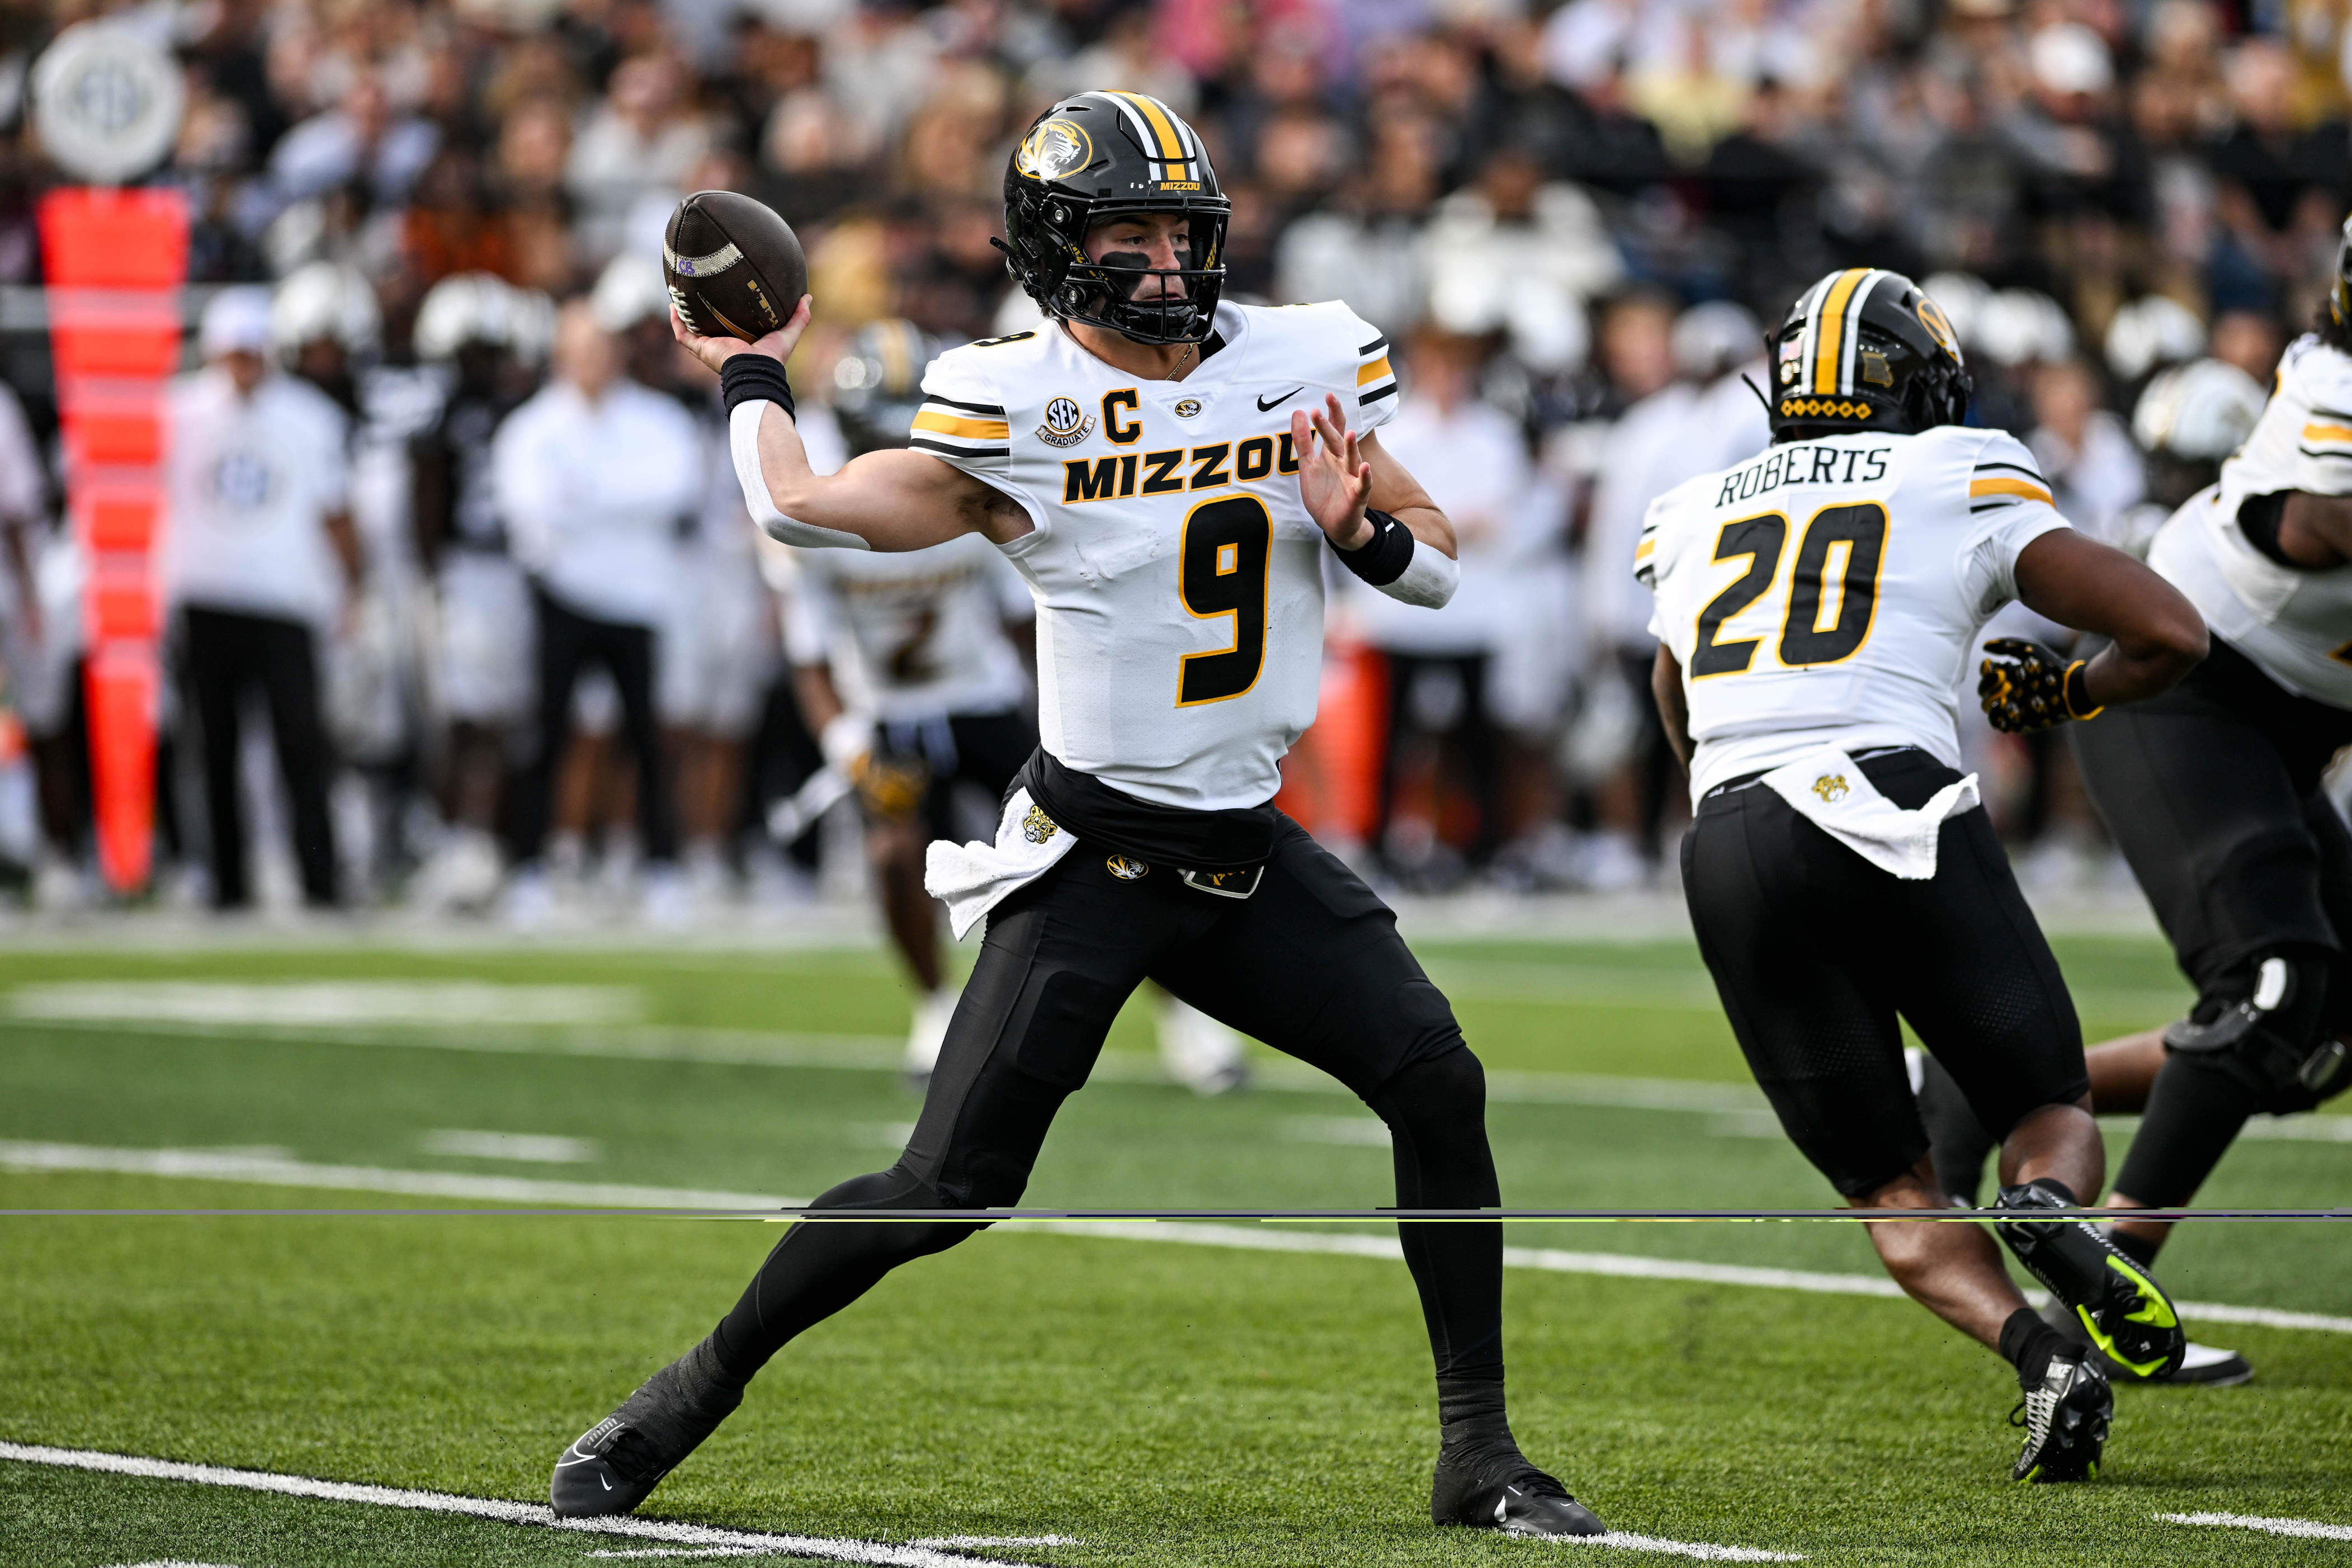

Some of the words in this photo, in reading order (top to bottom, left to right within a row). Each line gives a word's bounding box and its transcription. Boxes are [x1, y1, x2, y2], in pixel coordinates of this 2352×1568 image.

[1160, 182, 1200, 191] MIZZOU
[1044, 426, 1090, 446] GRADUATE
[1047, 398, 1078, 430] SEC
[1101, 388, 1144, 446] C
[1715, 446, 1891, 508] ROBERTS
[1175, 492, 1274, 709] 9
[1690, 499, 1891, 682] 20
